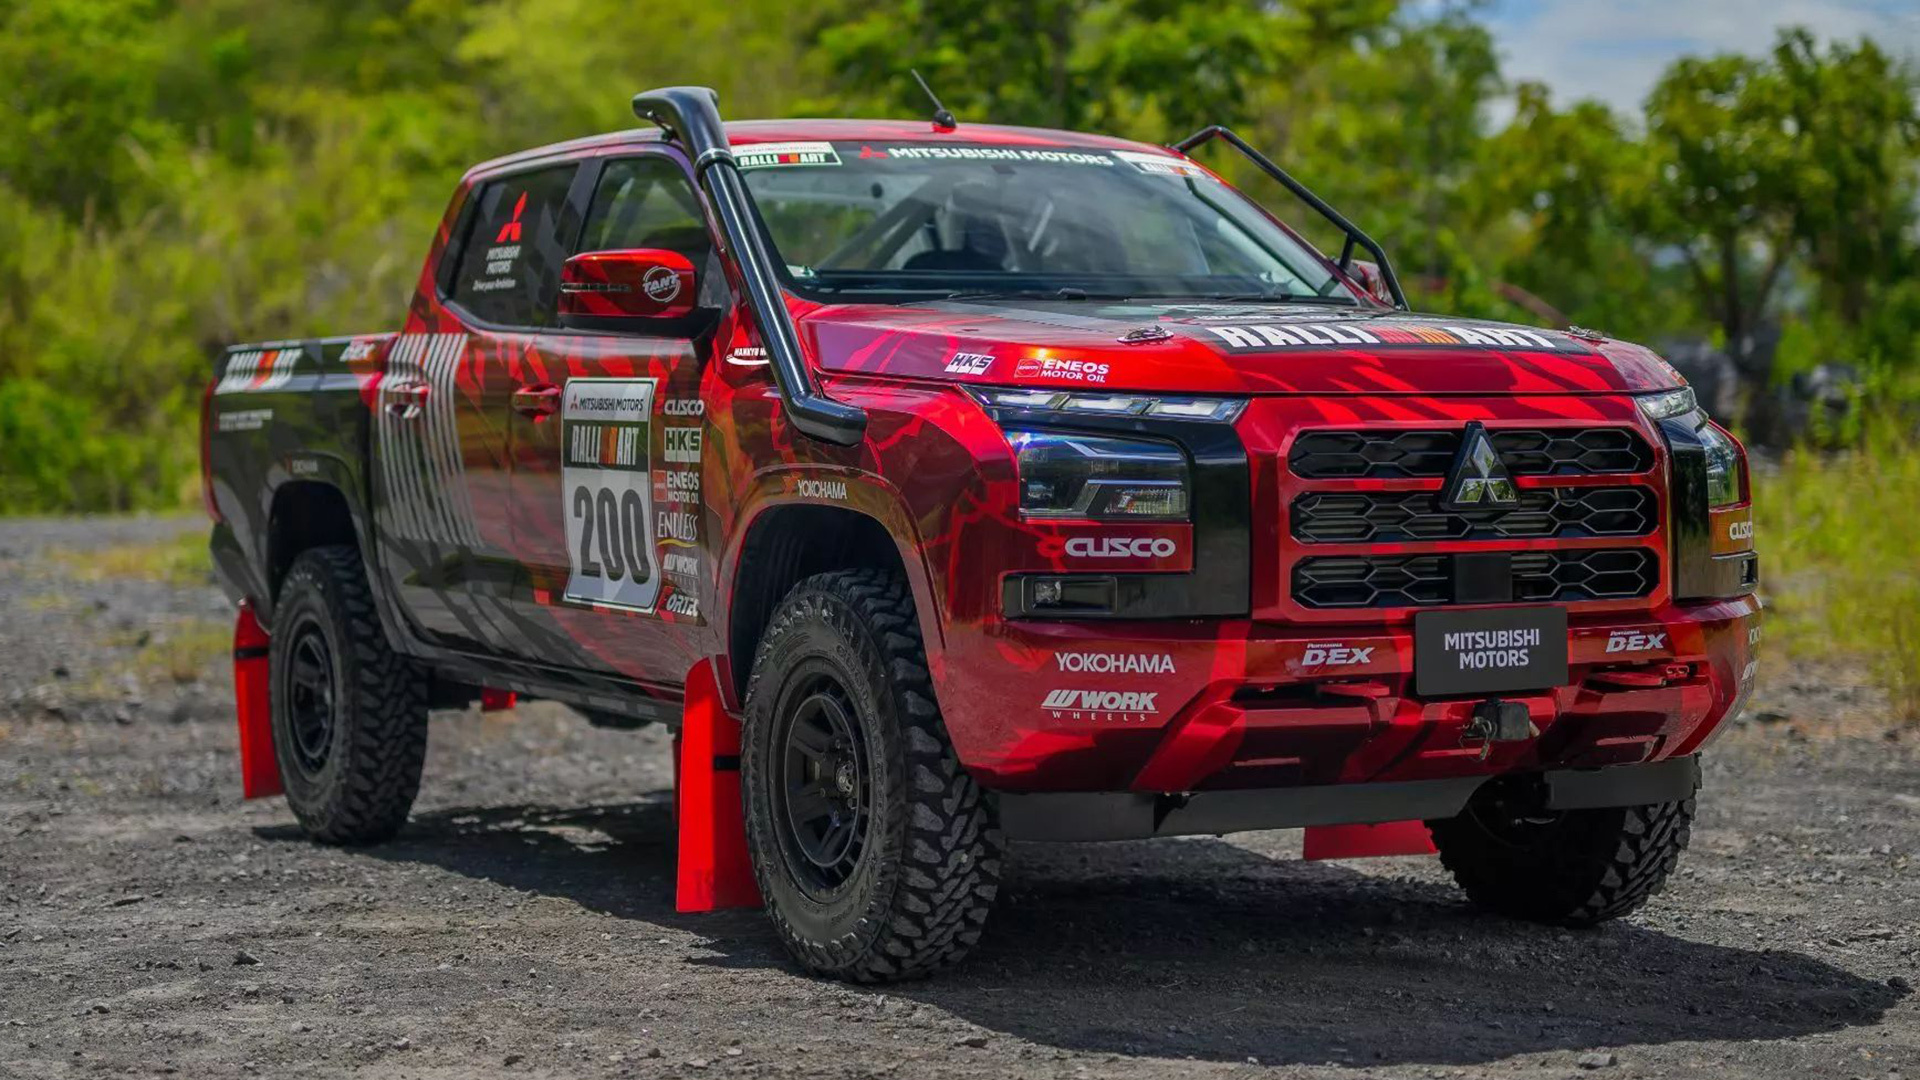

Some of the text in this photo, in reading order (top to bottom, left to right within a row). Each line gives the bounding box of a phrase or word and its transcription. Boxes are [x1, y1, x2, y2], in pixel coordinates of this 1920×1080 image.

[888, 147, 1115, 166] MITSUBISHI MOTORS
[642, 273, 680, 293] TANT
[1206, 325, 1556, 348] RALLI ART
[949, 353, 994, 370] HKS
[1043, 359, 1110, 375] ENEOS
[1040, 371, 1106, 383] MOTOR OIL
[579, 398, 644, 411] MITSUBISHI MOTORS
[664, 399, 705, 416] CUSCO
[571, 425, 639, 466] RALLI ART
[665, 429, 702, 453] HKS
[667, 470, 700, 490] ENEOS
[797, 479, 848, 500] YOKOHAMA
[668, 490, 700, 505] MOTOR OIL
[573, 485, 651, 585] 200
[657, 511, 699, 541] ENDLESS
[1065, 537, 1176, 557] CUSCO
[1444, 629, 1540, 651] MITSUBISHI
[1605, 633, 1666, 653] DEX
[1055, 652, 1176, 674] YOKOHAMA
[1301, 647, 1375, 666] DEX
[1458, 649, 1529, 670] MOTORS
[1079, 690, 1158, 711] WORK
[1052, 710, 1146, 722] WHEELS
